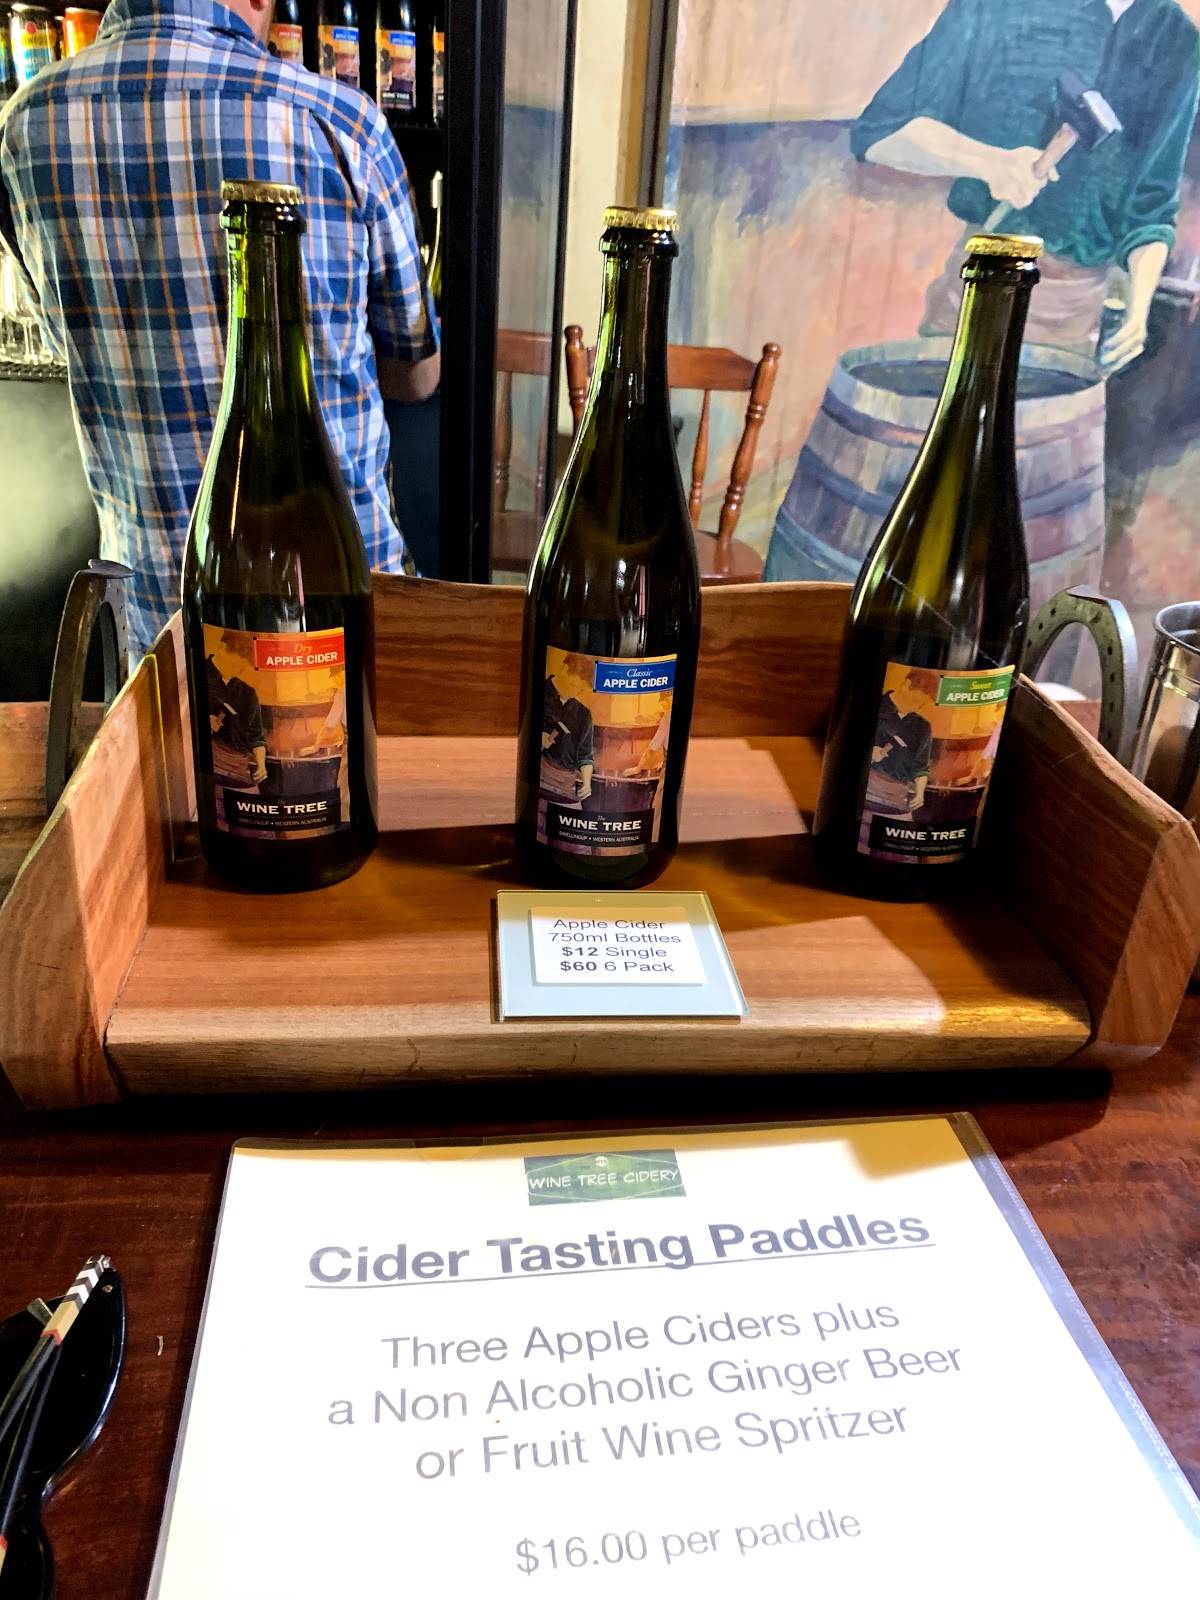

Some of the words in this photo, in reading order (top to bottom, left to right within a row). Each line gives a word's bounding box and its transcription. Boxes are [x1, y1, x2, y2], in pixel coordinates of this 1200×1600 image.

[266, 656, 304, 666] APPLE
[306, 652, 338, 664] CIDER
[626, 668, 653, 677] Classic
[603, 678, 638, 688] APPLE
[640, 676, 668, 688] CIDER
[946, 692, 980, 701] APPLE
[981, 688, 1005, 700] CIDER
[237, 801, 279, 814] WINE
[284, 801, 327, 814] TREE
[559, 815, 598, 830] WINE
[603, 820, 642, 831] TREE
[885, 827, 927, 840] WINE
[931, 828, 967, 840] TREE
[553, 919, 608, 931] Apple
[614, 919, 666, 930] Cider
[549, 932, 608, 943] 750ml
[615, 932, 681, 944] Bottles
[562, 946, 599, 957] $12
[605, 946, 667, 959] Single
[560, 961, 597, 972] $60
[604, 961, 617, 972] 6
[624, 961, 675, 972] Pack
[529, 1175, 571, 1189] WINE
[577, 1172, 617, 1187] TREE
[623, 1169, 679, 1184] CIDERY
[308, 1245, 470, 1284] Cider
[487, 1230, 694, 1273] Tasting
[708, 1213, 930, 1259] Paddles
[380, 1336, 508, 1369] Three
[523, 1320, 650, 1363] Apple
[663, 1311, 801, 1346] Ciders
[812, 1302, 900, 1342] plus
[328, 1400, 355, 1425] a
[374, 1388, 468, 1424] Non
[485, 1367, 694, 1414] Alcoholic
[707, 1358, 850, 1396] Ginger
[862, 1346, 961, 1379] Beer
[415, 1449, 465, 1480] or
[482, 1430, 589, 1473] Fruit
[601, 1423, 722, 1461] Wine
[734, 1405, 907, 1455] Spritzer
[516, 1530, 648, 1576] $16.00
[661, 1528, 721, 1565] per
[734, 1510, 862, 1556] paddle
